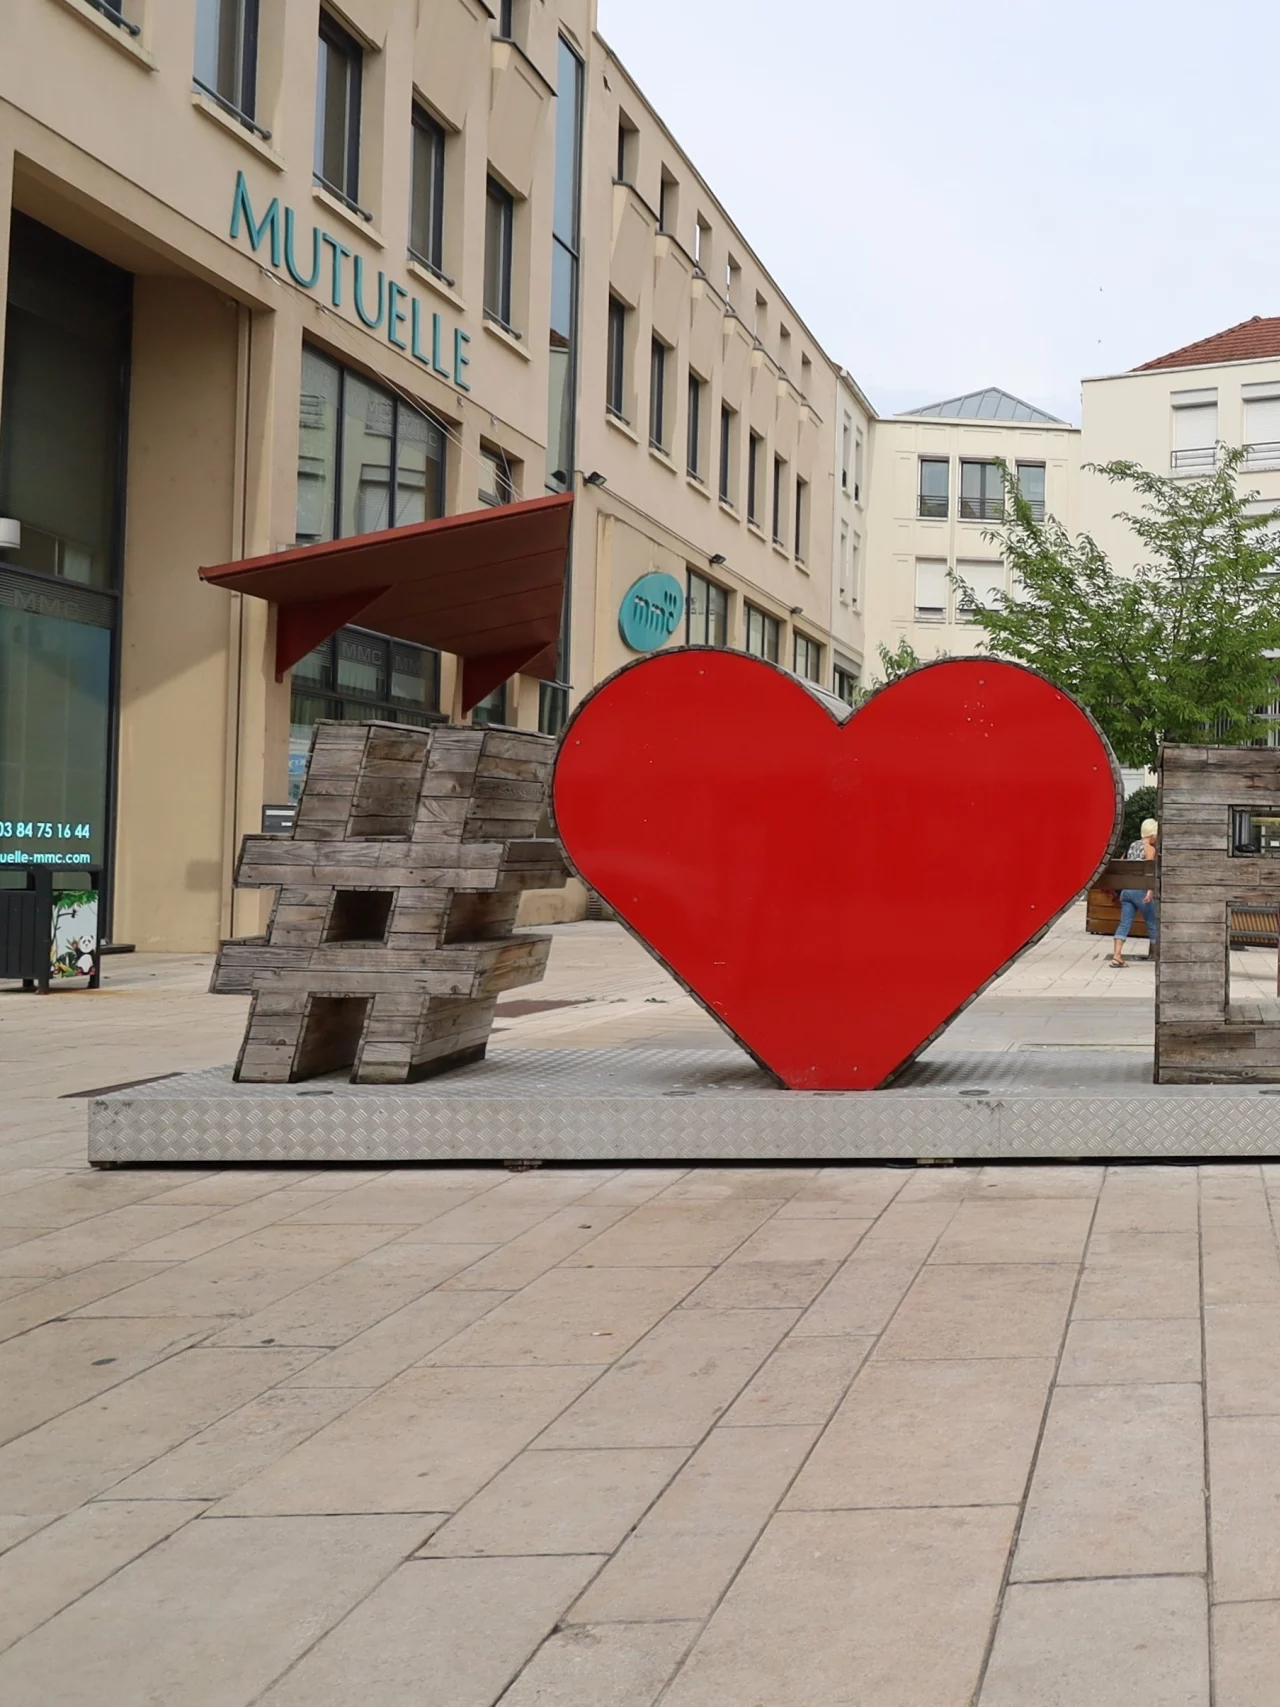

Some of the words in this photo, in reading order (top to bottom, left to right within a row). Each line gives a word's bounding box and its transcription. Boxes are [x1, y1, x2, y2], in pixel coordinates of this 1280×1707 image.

[229, 170, 471, 391] MUTUELLE
[13, 588, 79, 618] MMC
[341, 642, 383, 665] MMC
[16, 822, 33, 838] 84
[37, 822, 53, 838] 75
[57, 823, 71, 838] 16
[74, 824, 90, 839] 44
